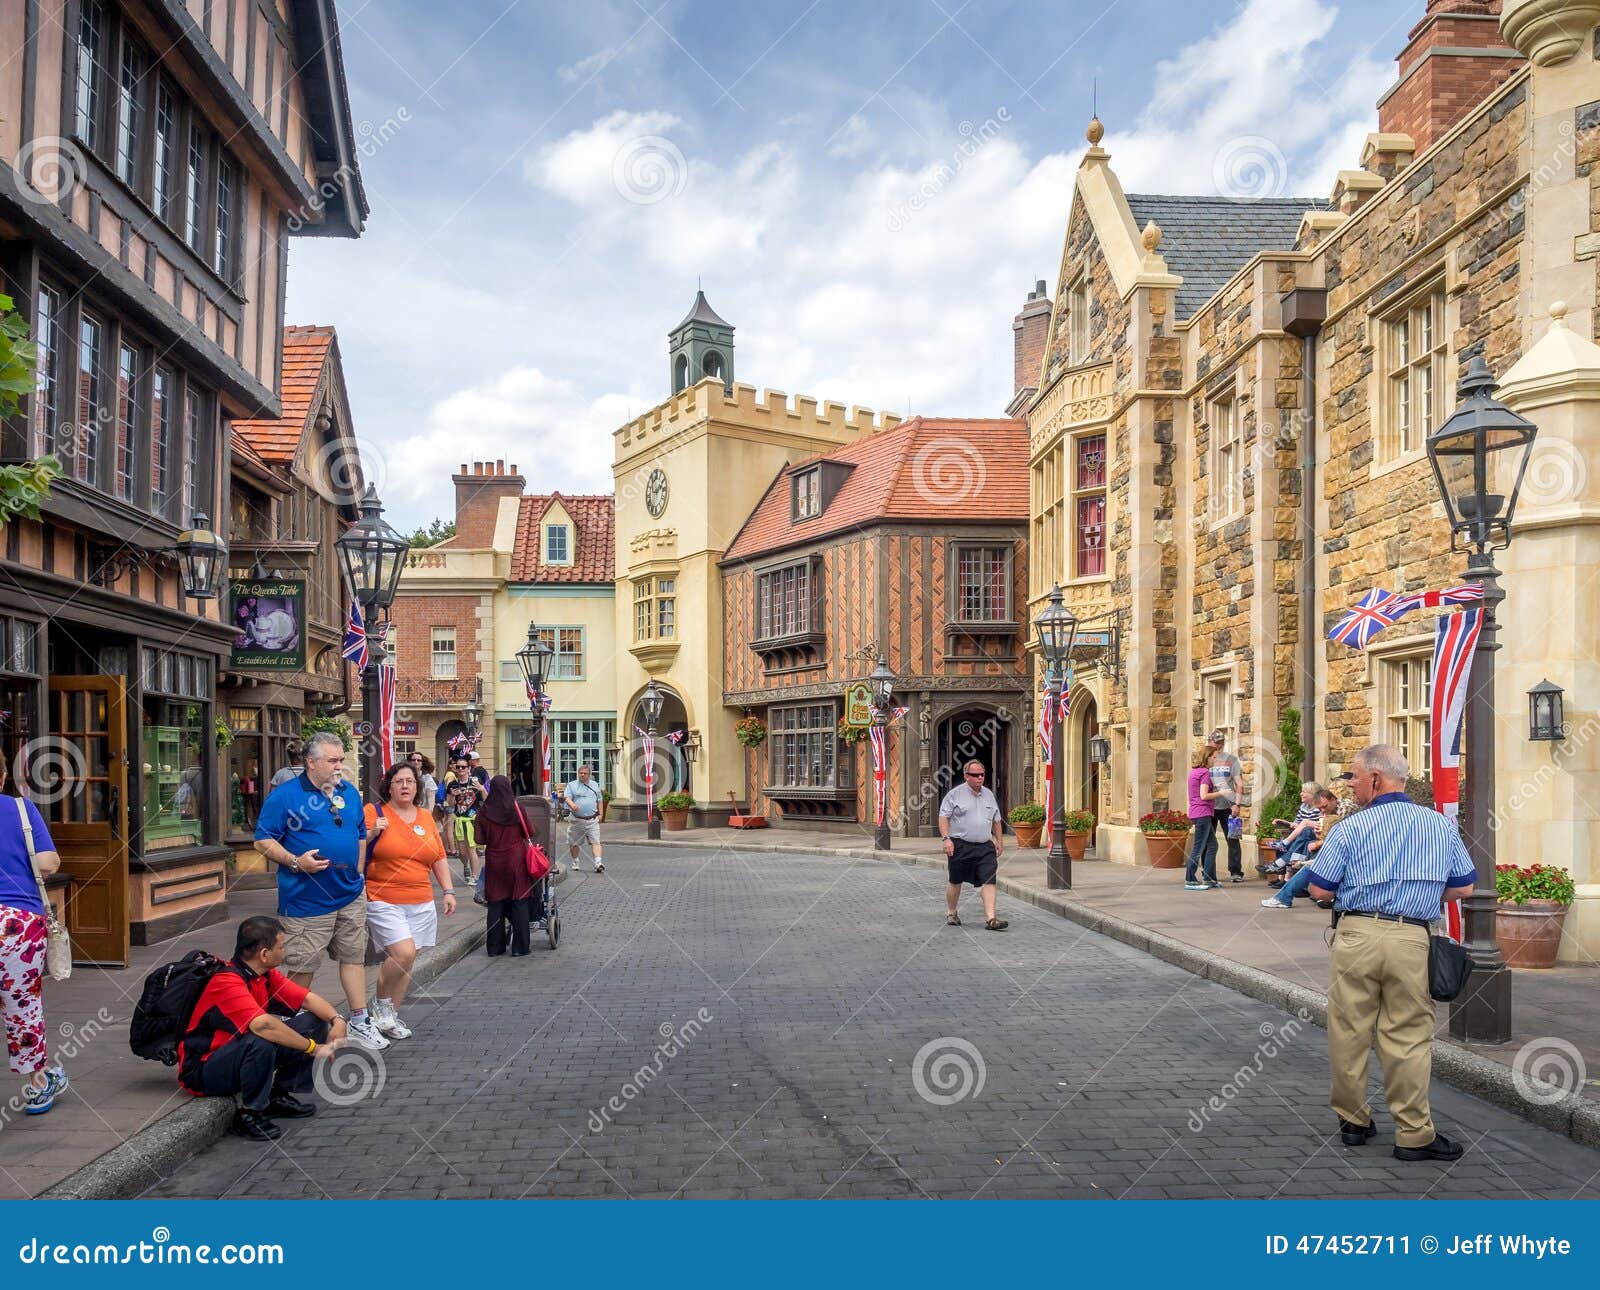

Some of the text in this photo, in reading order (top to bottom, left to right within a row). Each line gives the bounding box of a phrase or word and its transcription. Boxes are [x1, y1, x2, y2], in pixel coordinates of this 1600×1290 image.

[235, 583, 250, 595] The
[279, 584, 298, 595] Table
[237, 656, 297, 664] Established 1702
